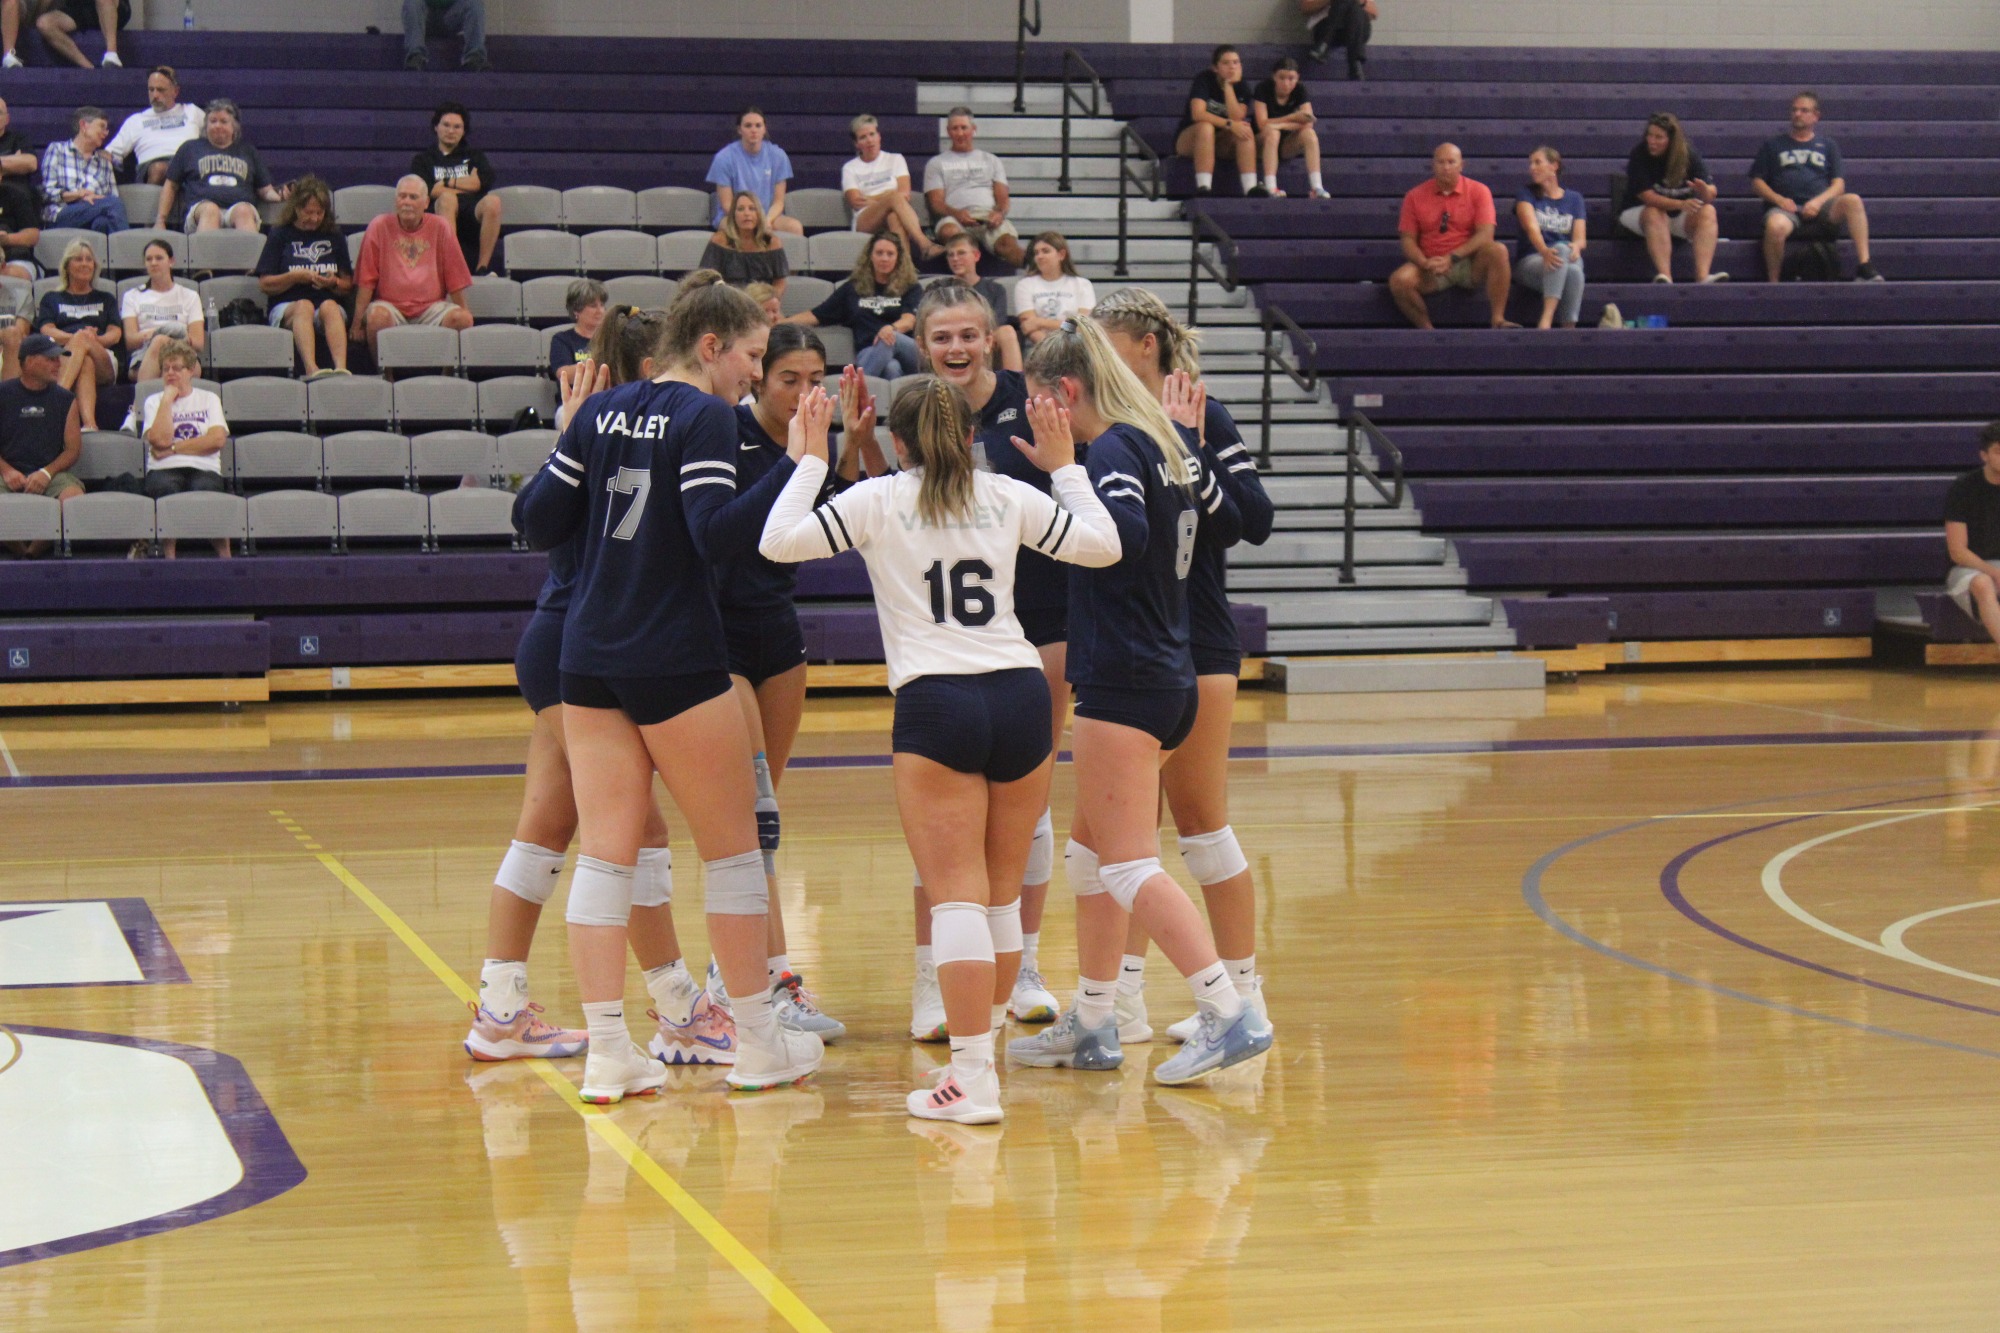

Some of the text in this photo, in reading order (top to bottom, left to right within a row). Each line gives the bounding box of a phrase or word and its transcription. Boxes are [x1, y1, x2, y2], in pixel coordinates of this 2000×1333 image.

[1779, 149, 1826, 167] LVC
[1174, 509, 1199, 580] 8
[921, 556, 998, 628] 16
